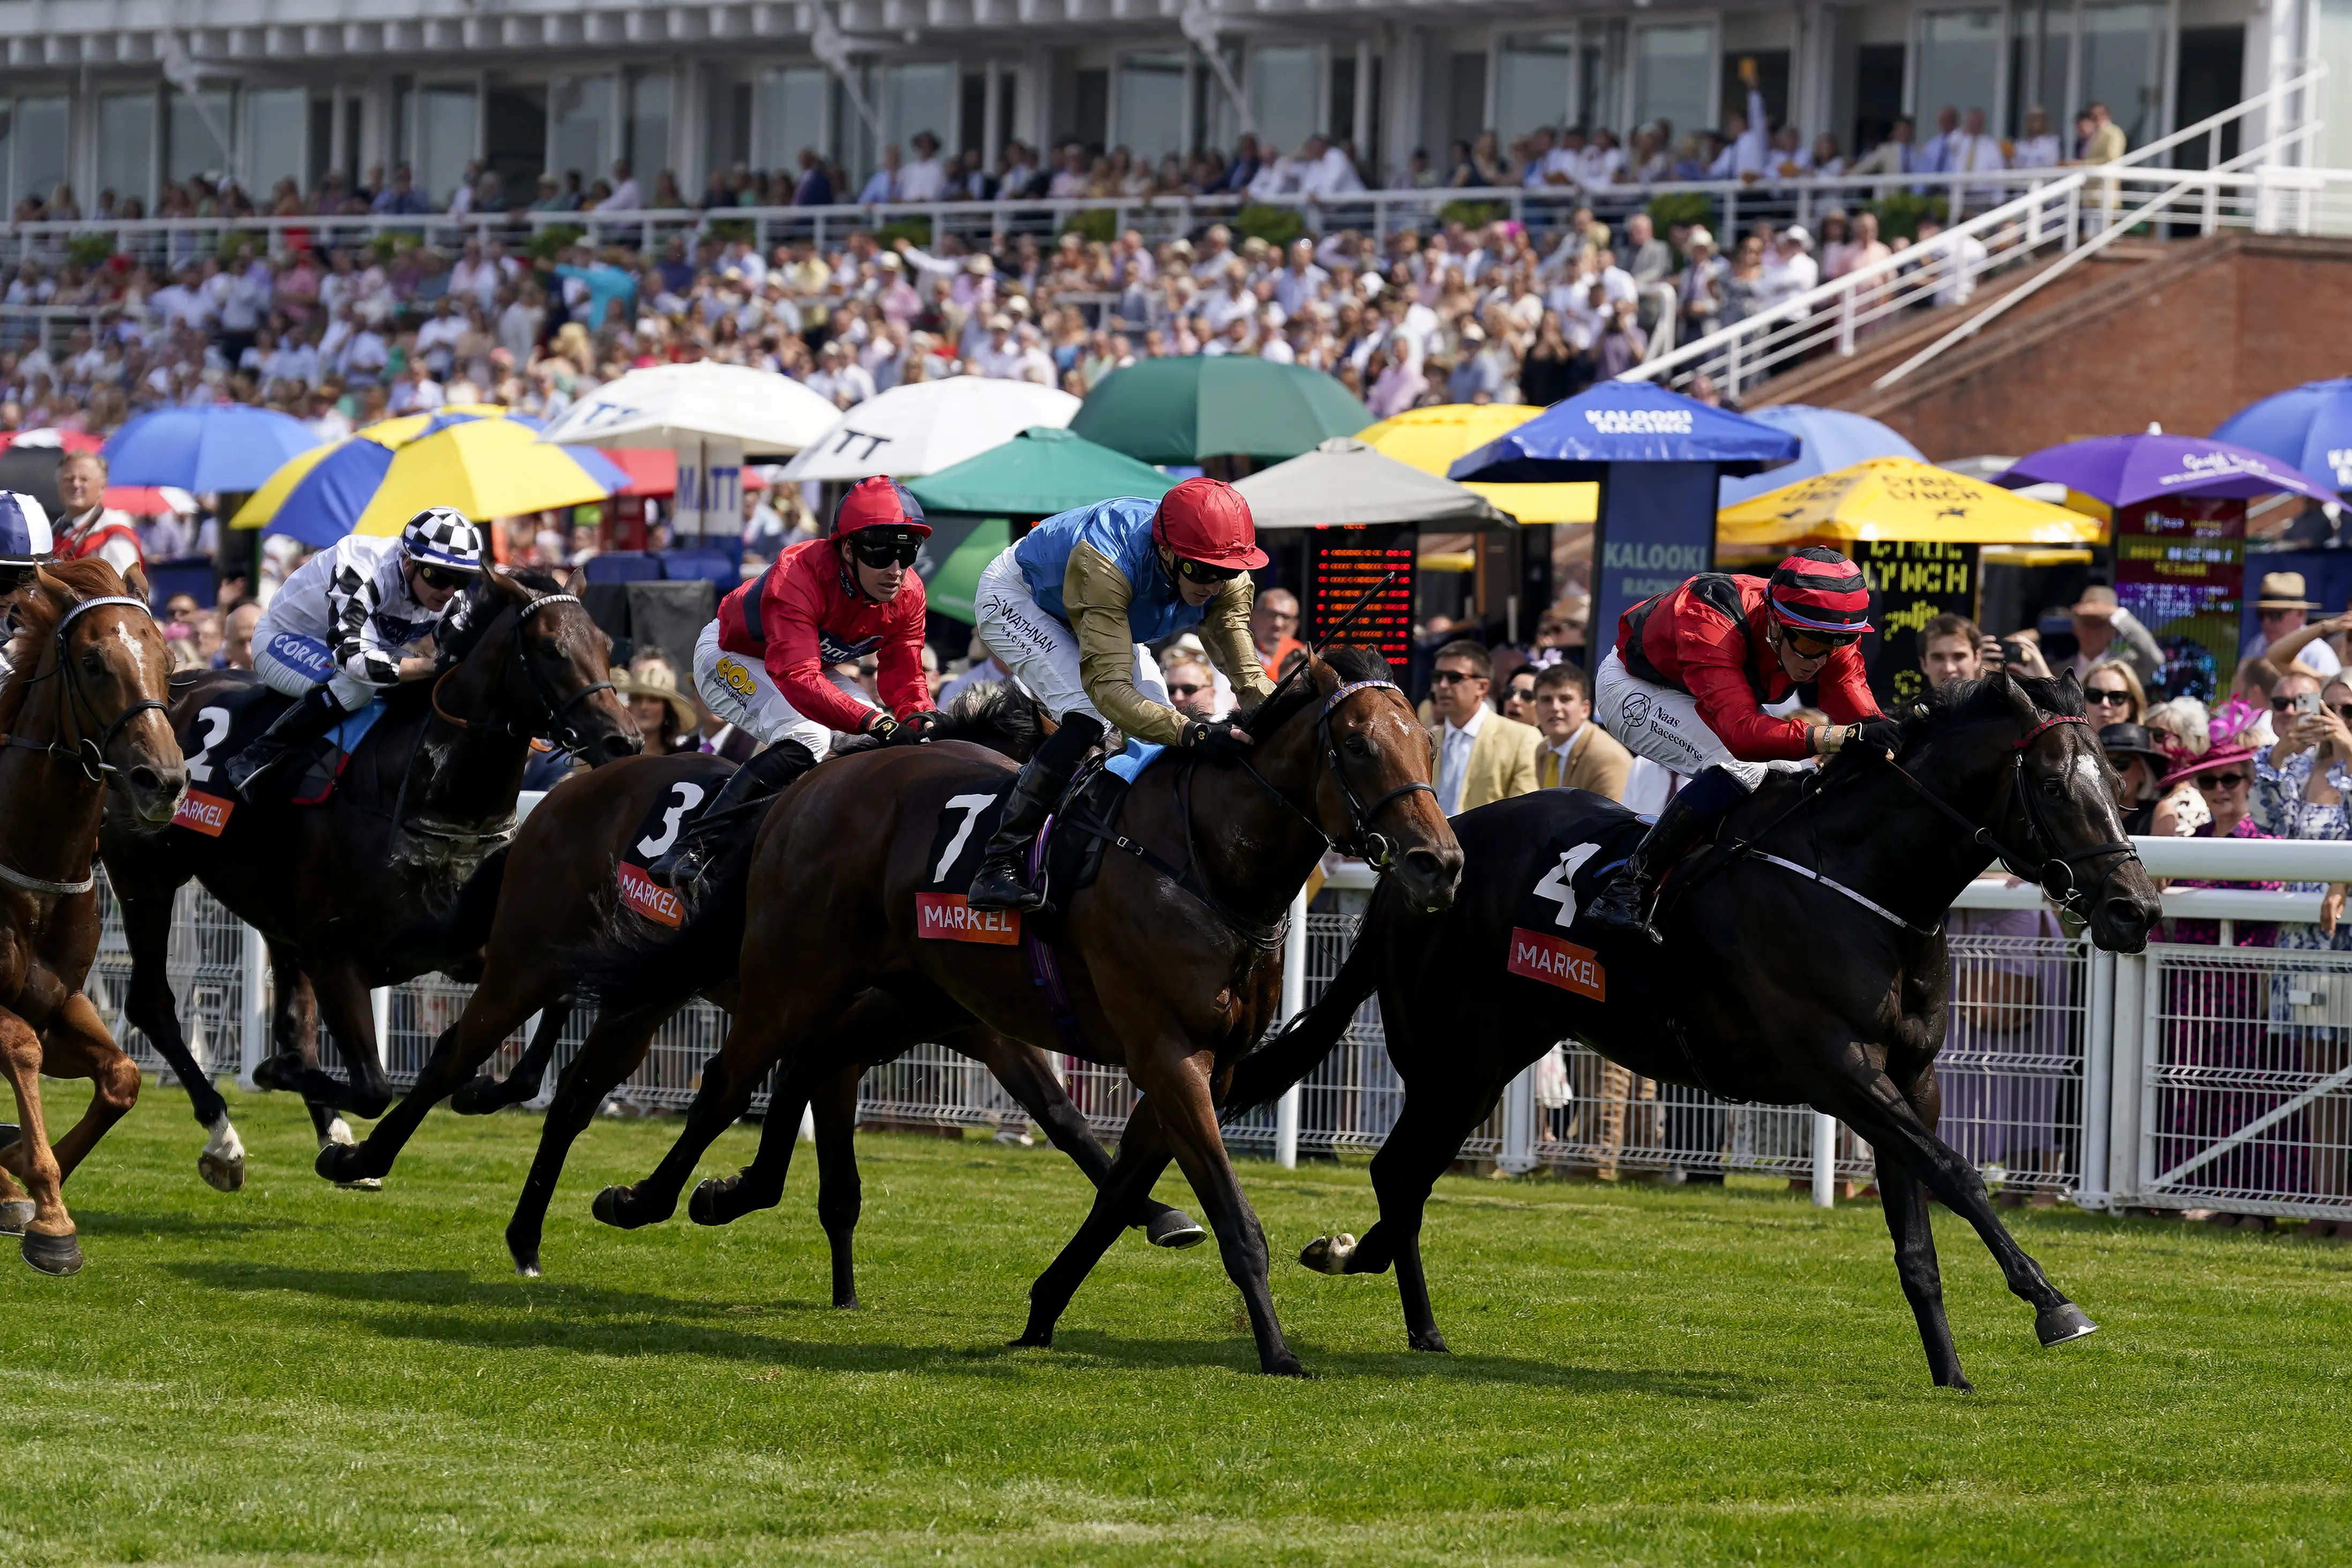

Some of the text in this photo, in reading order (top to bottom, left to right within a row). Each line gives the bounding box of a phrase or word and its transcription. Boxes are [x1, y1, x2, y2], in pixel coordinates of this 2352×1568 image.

[1604, 542, 1707, 571] KALOOKI
[1001, 602, 1058, 653] WATHNAN
[1001, 625, 1032, 655] RACING
[274, 635, 327, 672] CORAL
[713, 677, 748, 711] ACTIVATION
[716, 657, 757, 697] POP
[1654, 706, 1680, 728] Naas
[184, 706, 229, 782] 2
[1650, 720, 1703, 762] Racecourse
[178, 798, 222, 827] ARKEL
[637, 782, 704, 858] 3
[933, 794, 997, 883] 7
[623, 874, 678, 918] MARKEL
[1533, 842, 1601, 927] 4
[925, 906, 1012, 931] MARKEL
[1517, 943, 1599, 988] MARKEL
